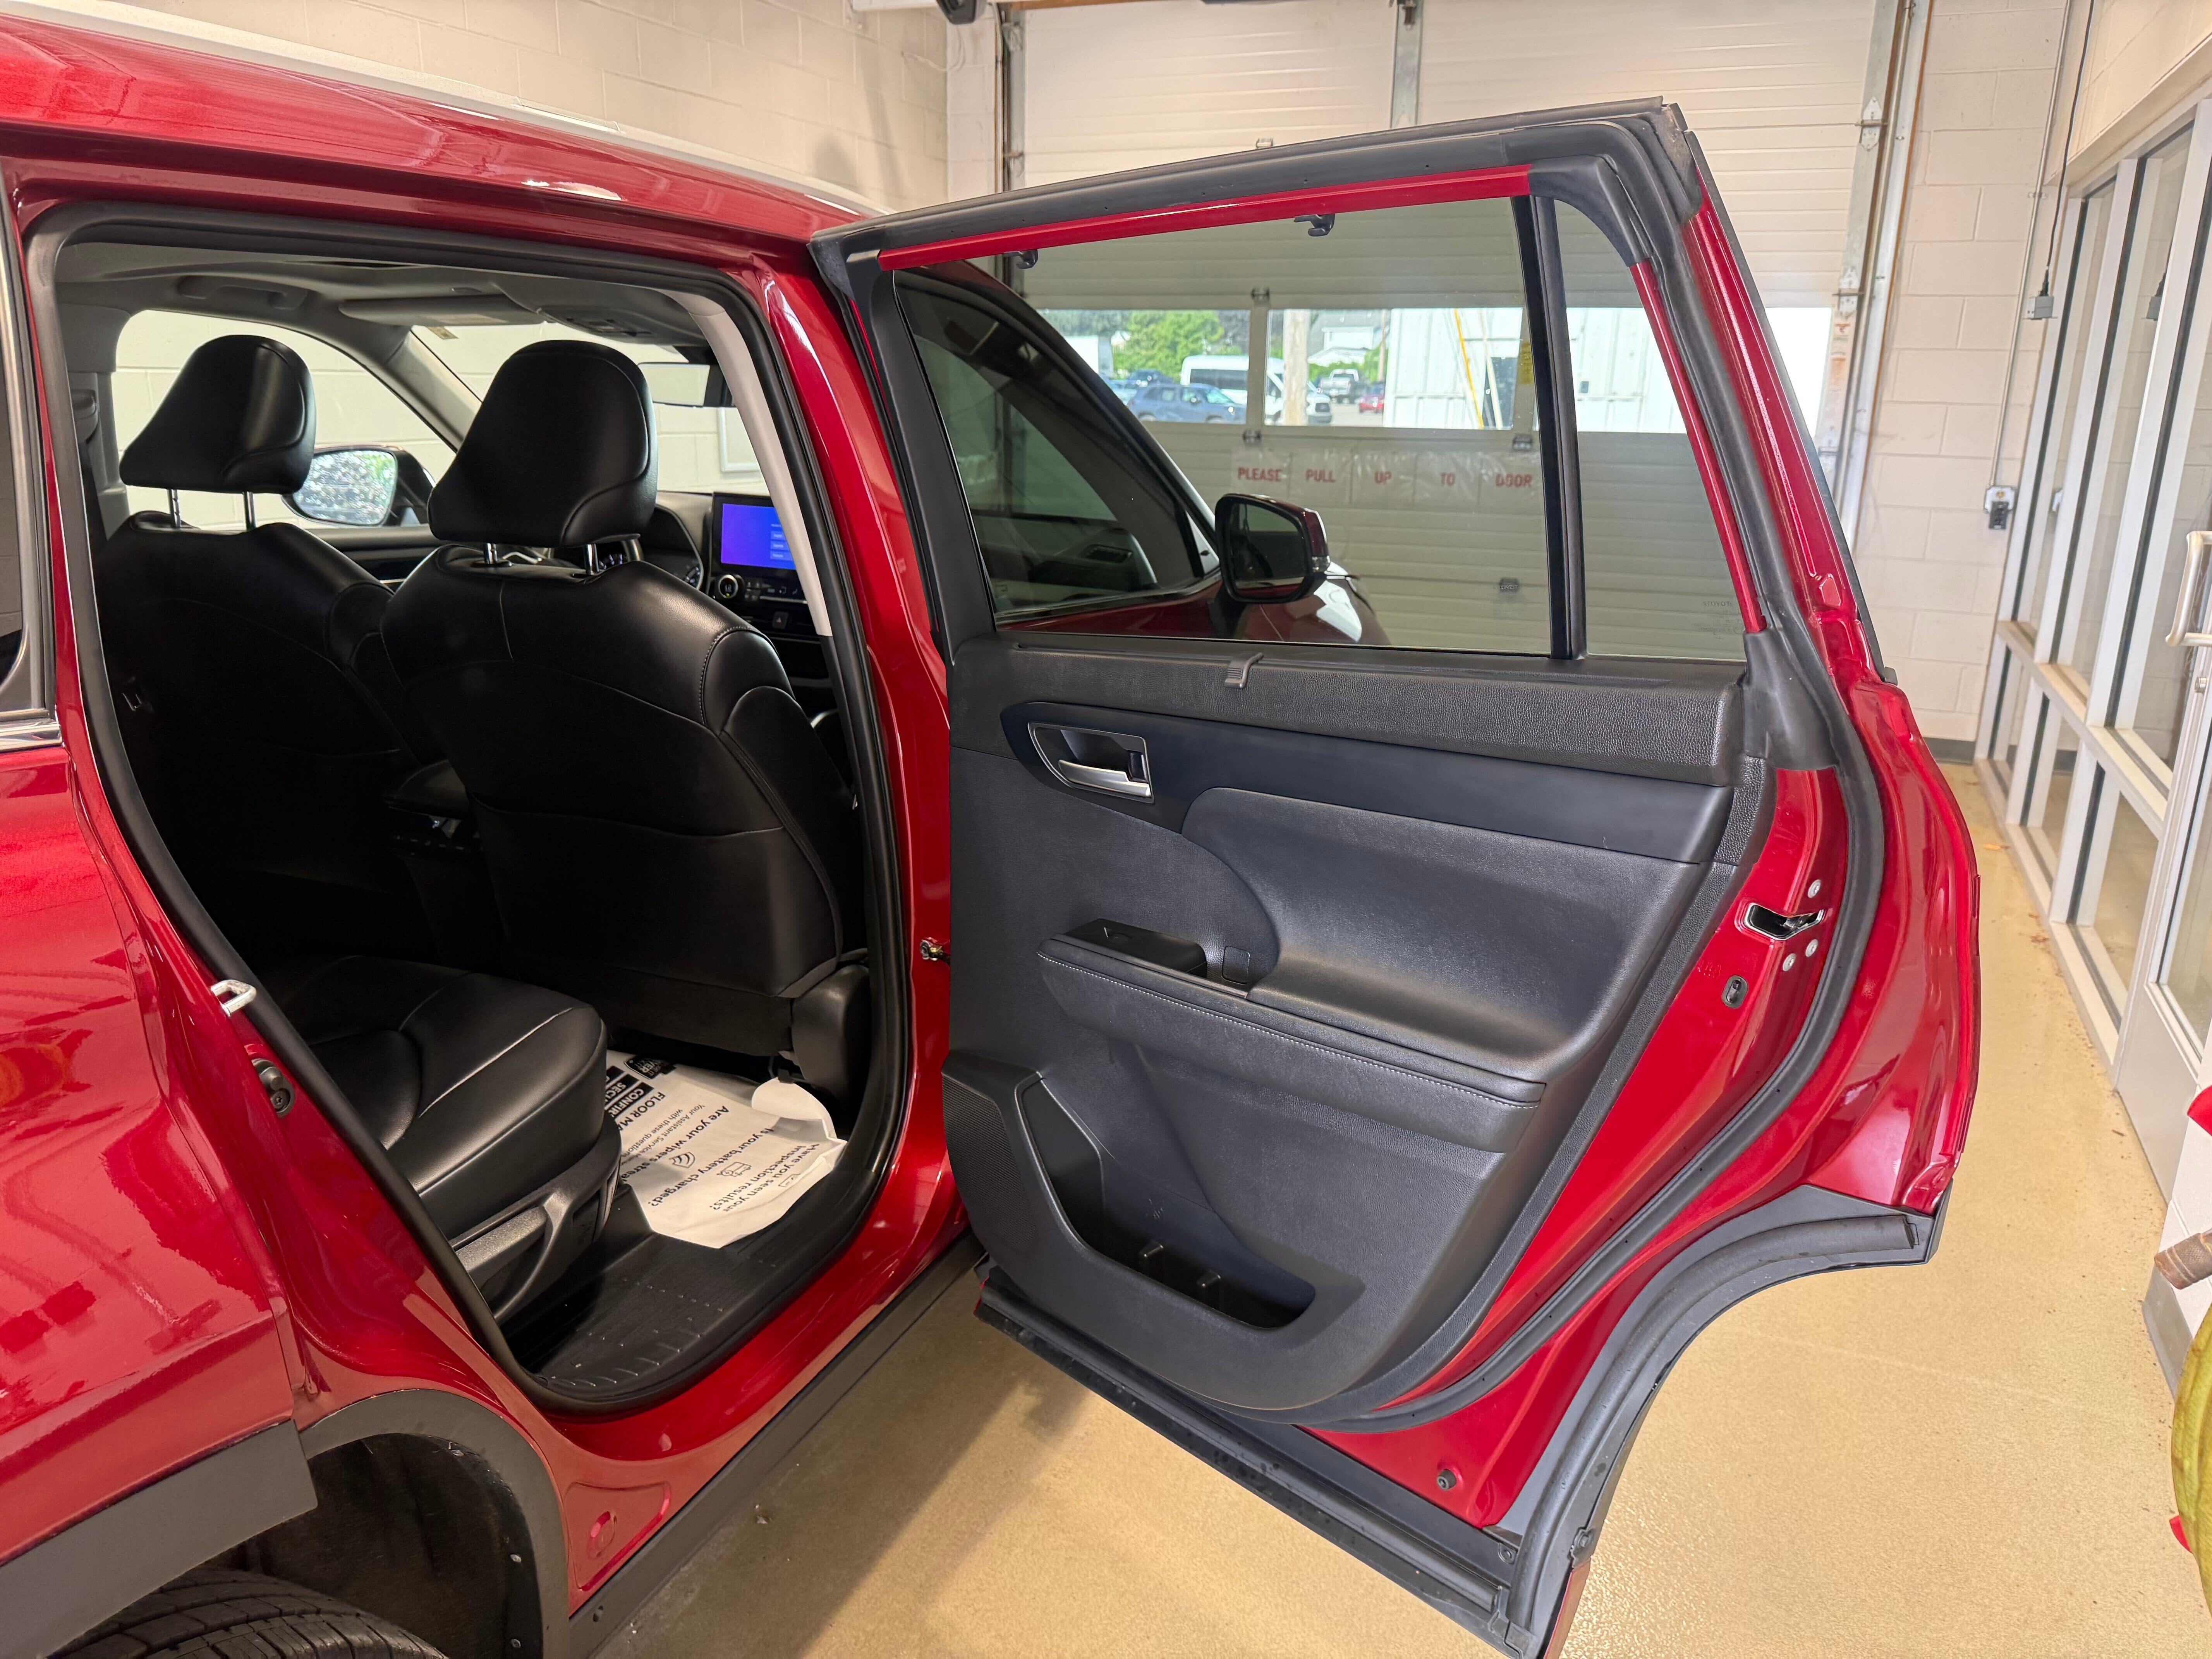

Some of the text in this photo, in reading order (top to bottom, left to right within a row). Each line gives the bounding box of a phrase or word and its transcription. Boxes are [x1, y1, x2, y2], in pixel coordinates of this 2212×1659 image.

[1237, 467, 1533, 488] PLEASE PULL UP TO DOOR
[608, 1088, 644, 1118] CONFIR
[617, 1092, 666, 1131] FLOOR MA
[690, 1104, 706, 1115] Your
[708, 1105, 730, 1120] Are
[668, 1109, 683, 1120] with
[651, 1119, 670, 1134] these
[661, 1115, 690, 1137] Assistant
[686, 1119, 711, 1140] your
[649, 1140, 687, 1162] wipers
[738, 1133, 763, 1151] your
[697, 1149, 743, 1174] battery
[723, 1143, 819, 1212] Have you seen your
[648, 1174, 699, 1207] charged?
[709, 1182, 752, 1210] results?
